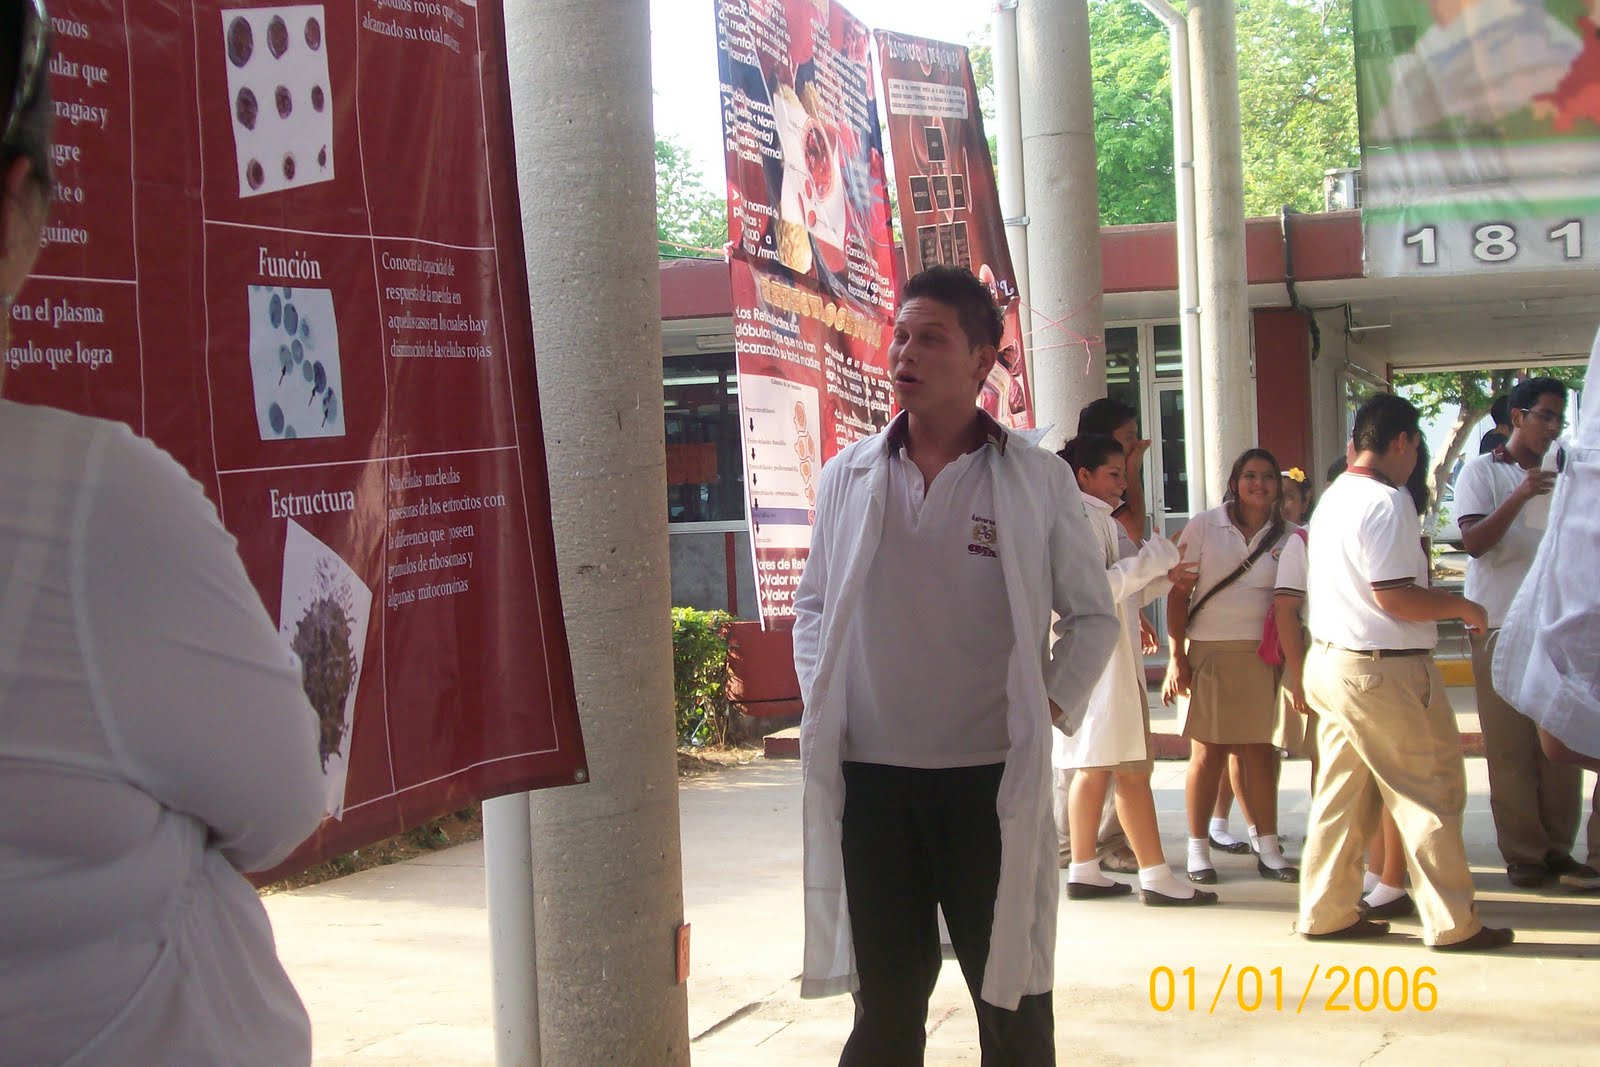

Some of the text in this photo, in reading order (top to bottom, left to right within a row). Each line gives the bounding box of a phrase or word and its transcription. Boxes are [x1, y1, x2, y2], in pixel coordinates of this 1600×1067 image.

[414, 1, 440, 19] rojos
[362, 11, 402, 38] alcanzado
[404, 27, 418, 40] su
[419, 26, 443, 44] total
[49, 51, 108, 88] ular que
[55, 97, 107, 129] ragias y
[74, 187, 83, 203] o
[258, 246, 322, 280] Función
[452, 293, 462, 304] en
[12, 297, 104, 329] en el plasma
[446, 314, 468, 331] cuales
[469, 314, 488, 336] hay
[735, 323, 771, 340] glóbulos
[45, 347, 73, 371] que
[76, 340, 113, 370] logra
[467, 342, 492, 362] rojas
[269, 488, 355, 518] Estructura
[419, 498, 429, 516] de
[429, 497, 441, 514] los
[484, 494, 506, 508] con
[394, 528, 428, 548] diferencia
[429, 529, 444, 547] que
[417, 554, 428, 571] de
[467, 551, 474, 568] y
[777, 558, 791, 571] de
[765, 574, 801, 586] Valor no
[388, 588, 415, 611] algunas
[766, 589, 790, 601] Valor
